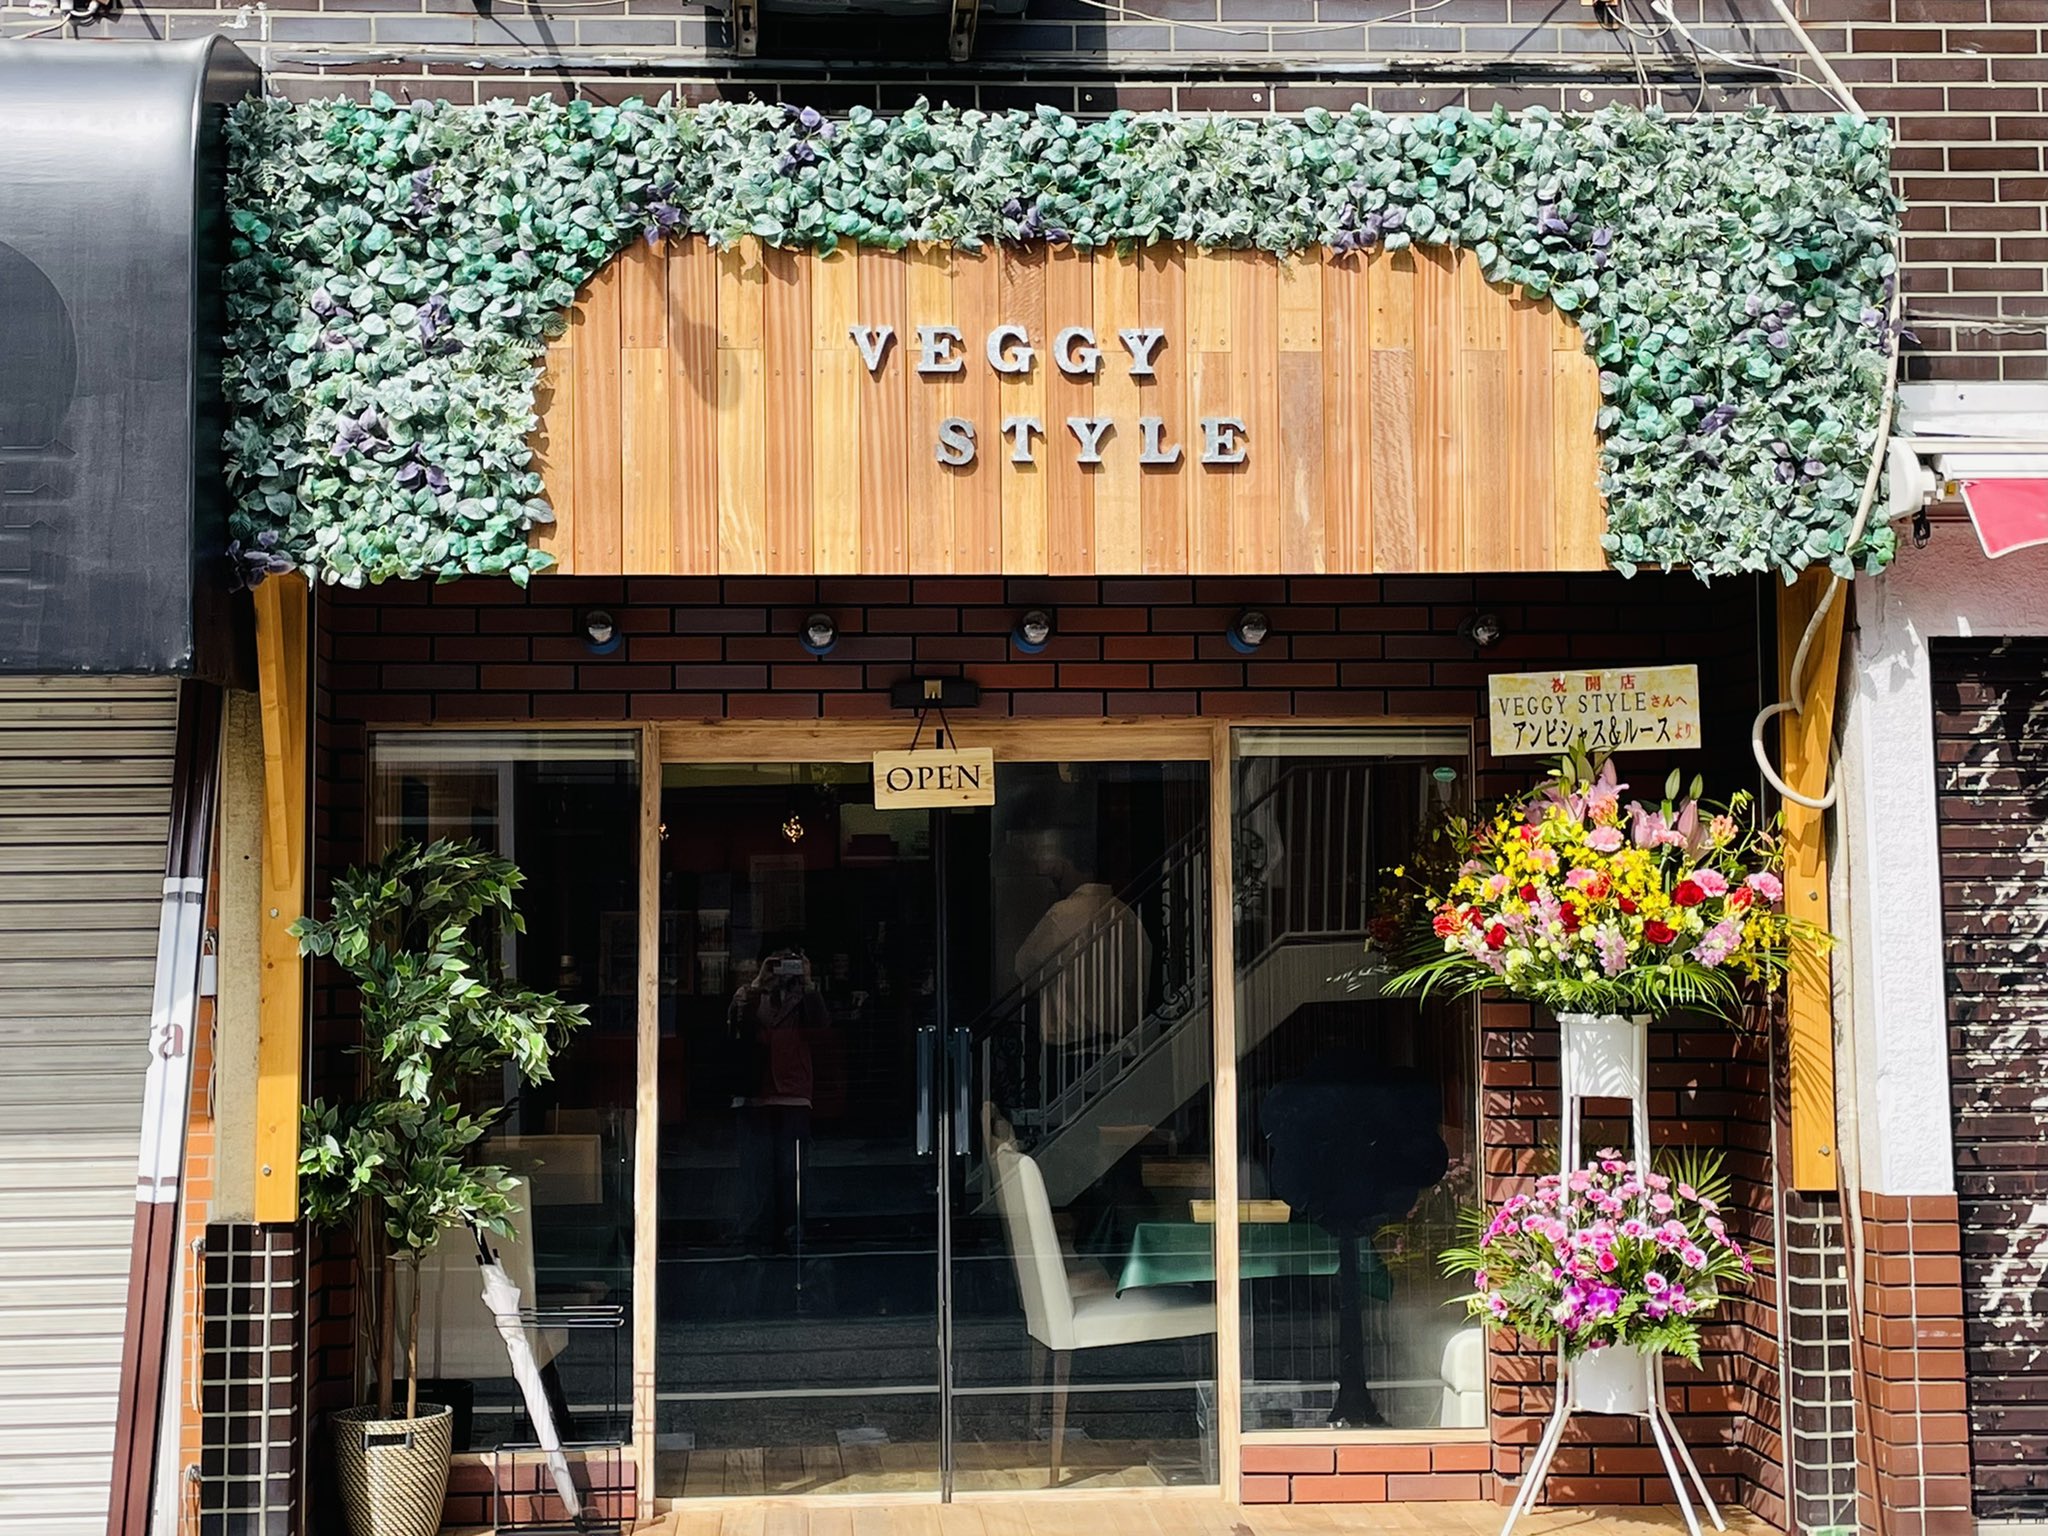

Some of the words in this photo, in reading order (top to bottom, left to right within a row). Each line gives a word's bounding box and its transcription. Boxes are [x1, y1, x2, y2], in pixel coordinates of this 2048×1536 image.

[849, 325, 1168, 376] VEGGY
[935, 416, 1247, 467] STYLE
[1498, 695, 1567, 717] VEGGY
[886, 764, 981, 792] OPEN
